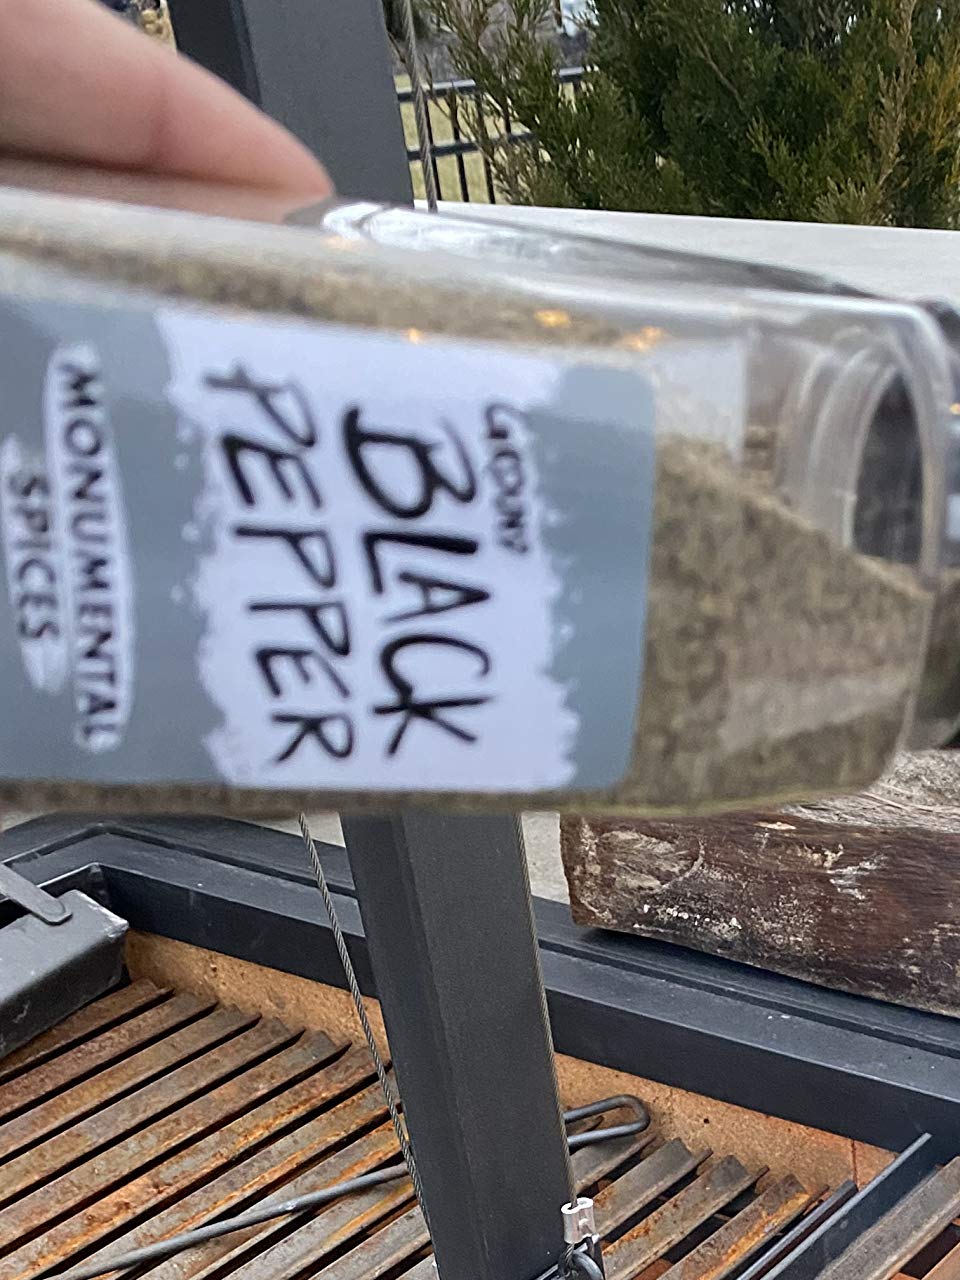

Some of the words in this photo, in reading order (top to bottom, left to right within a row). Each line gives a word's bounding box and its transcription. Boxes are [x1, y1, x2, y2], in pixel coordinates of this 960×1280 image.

[9, 468, 60, 642] SPICES
[60, 362, 121, 743] MONUMENTAL
[203, 365, 356, 764] PEPPER
[343, 406, 492, 756] BLACK
